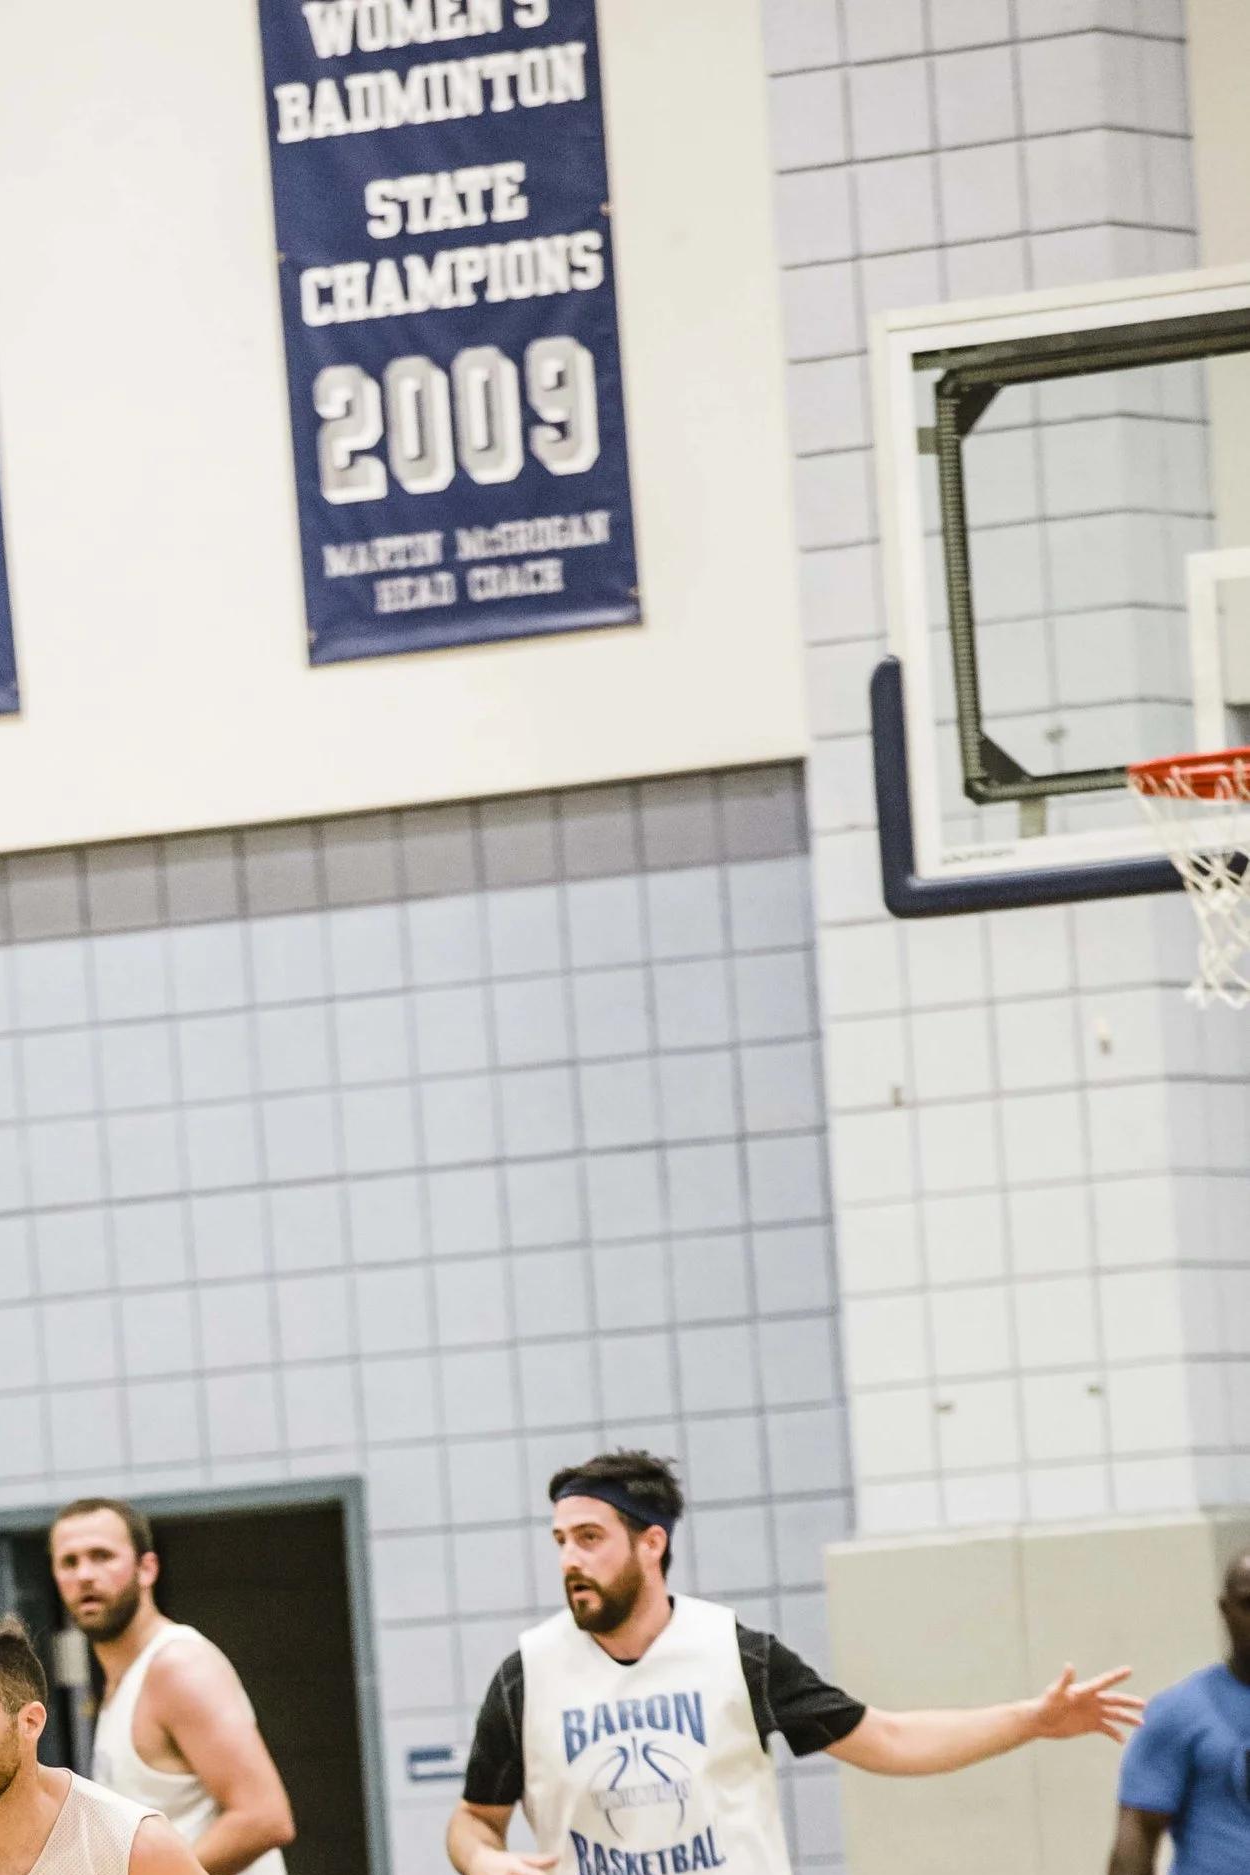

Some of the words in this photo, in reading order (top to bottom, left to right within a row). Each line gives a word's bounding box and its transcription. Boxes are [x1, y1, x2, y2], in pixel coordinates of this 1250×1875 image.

[302, 0, 550, 59] WOMENS
[274, 42, 587, 143] BADMINTON
[364, 161, 529, 240] STATE
[300, 230, 604, 327] CHAMPIONS
[312, 334, 600, 505] 2009
[374, 571, 457, 614] HEAD
[467, 557, 564, 602] COACH
[562, 1690, 707, 1765] BARON
